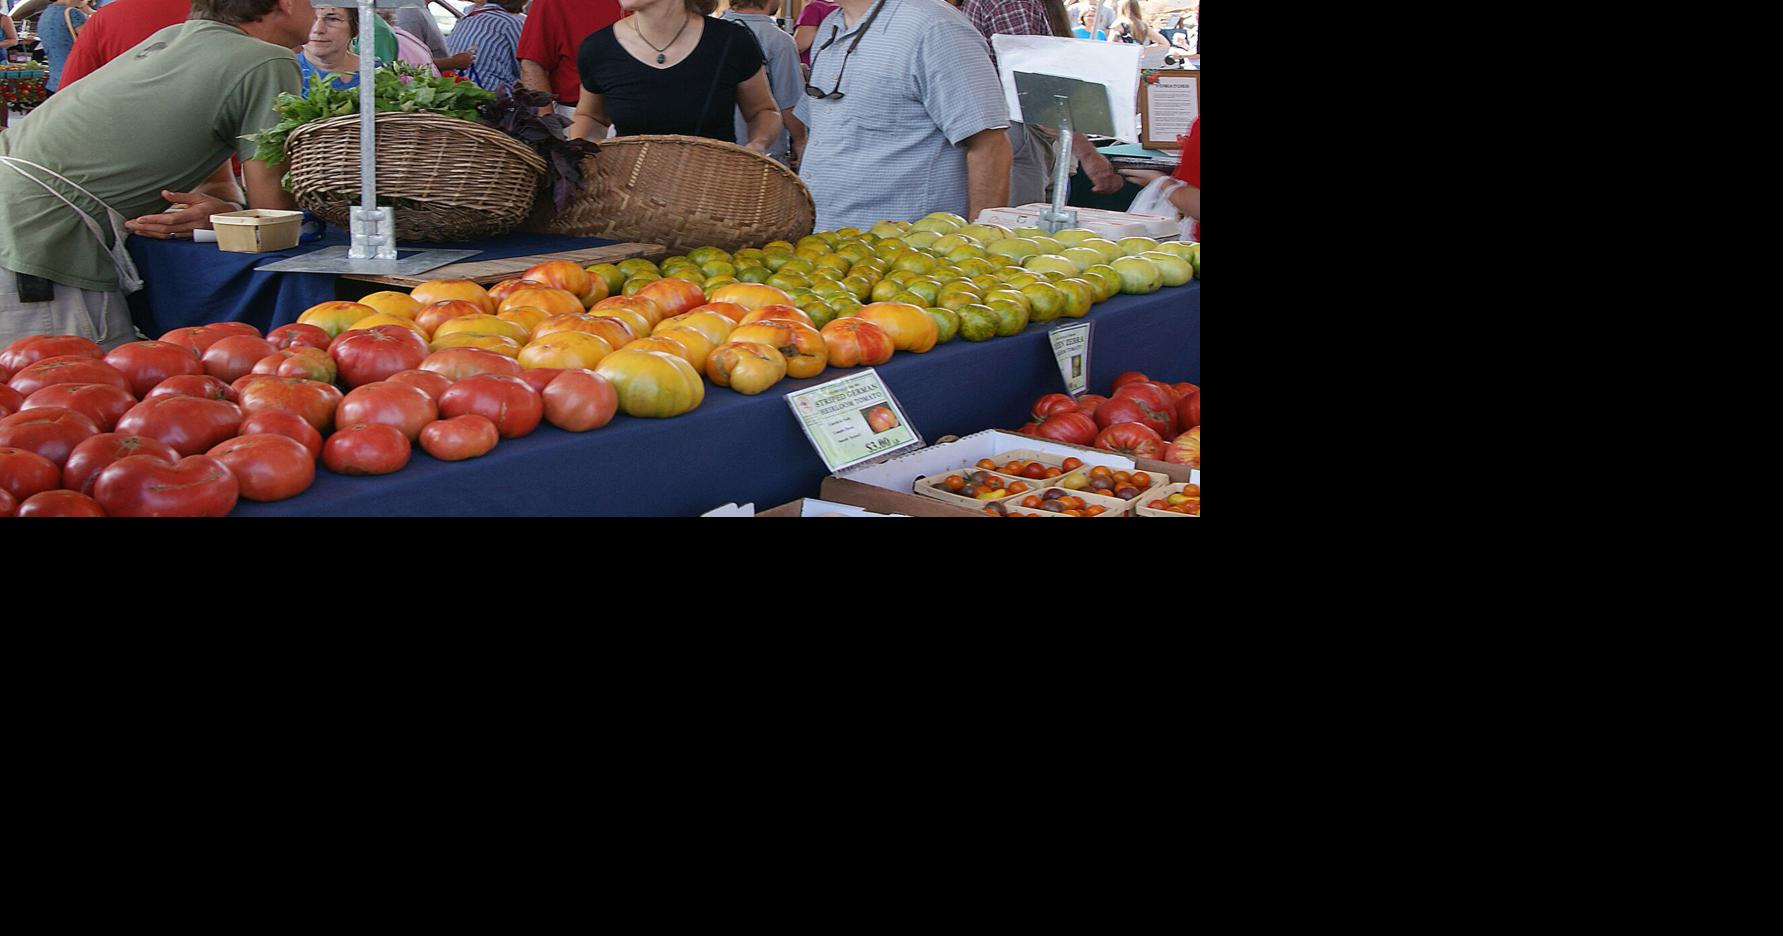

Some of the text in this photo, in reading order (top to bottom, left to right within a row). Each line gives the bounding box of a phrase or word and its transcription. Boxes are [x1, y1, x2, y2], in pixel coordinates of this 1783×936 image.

[815, 393, 847, 408] STRIPED
[847, 384, 879, 397] GERMAN
[820, 391, 882, 415] HEIRLOOM TOMATO
